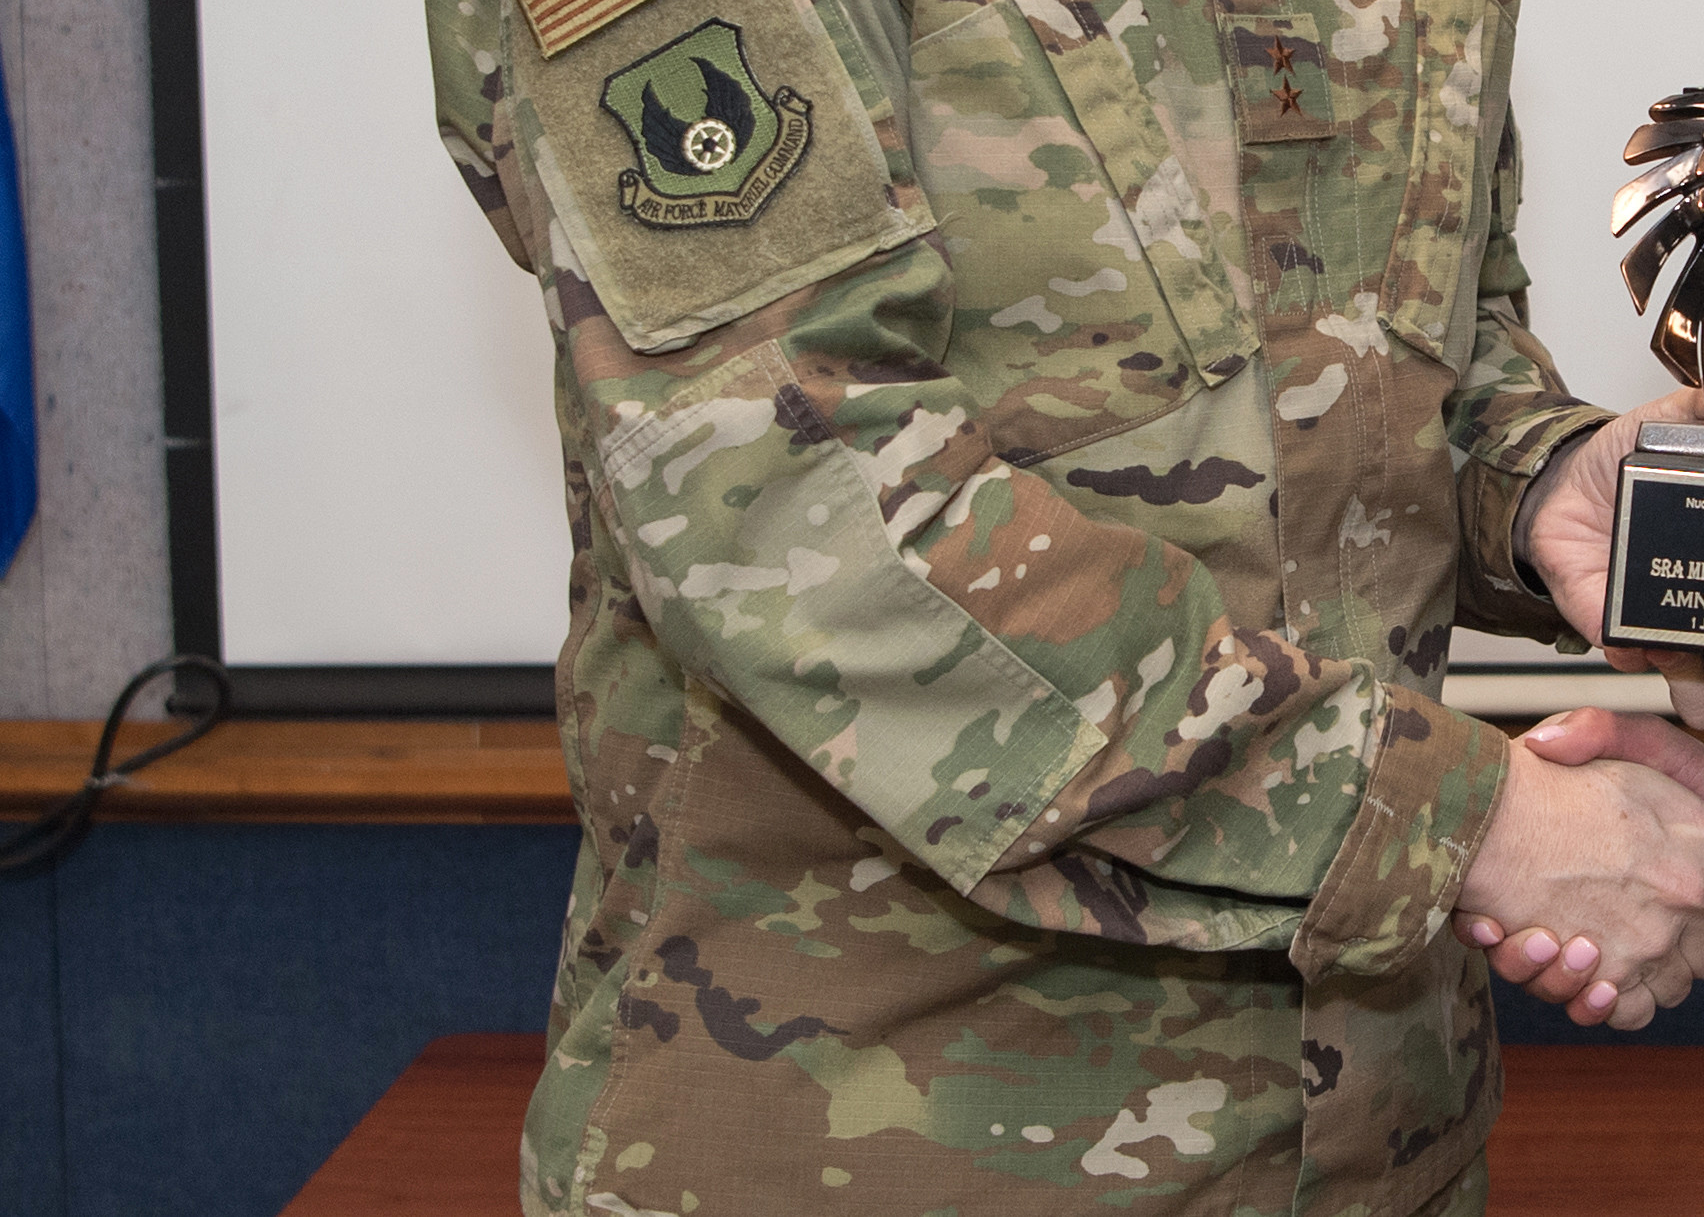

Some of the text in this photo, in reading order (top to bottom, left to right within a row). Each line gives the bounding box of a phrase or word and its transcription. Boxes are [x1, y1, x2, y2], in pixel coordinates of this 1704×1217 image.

[637, 118, 804, 220] AIR FORCE MATERIEL COMMAND
[1650, 557, 1684, 579] SRA
[1691, 616, 1696, 629] 1
